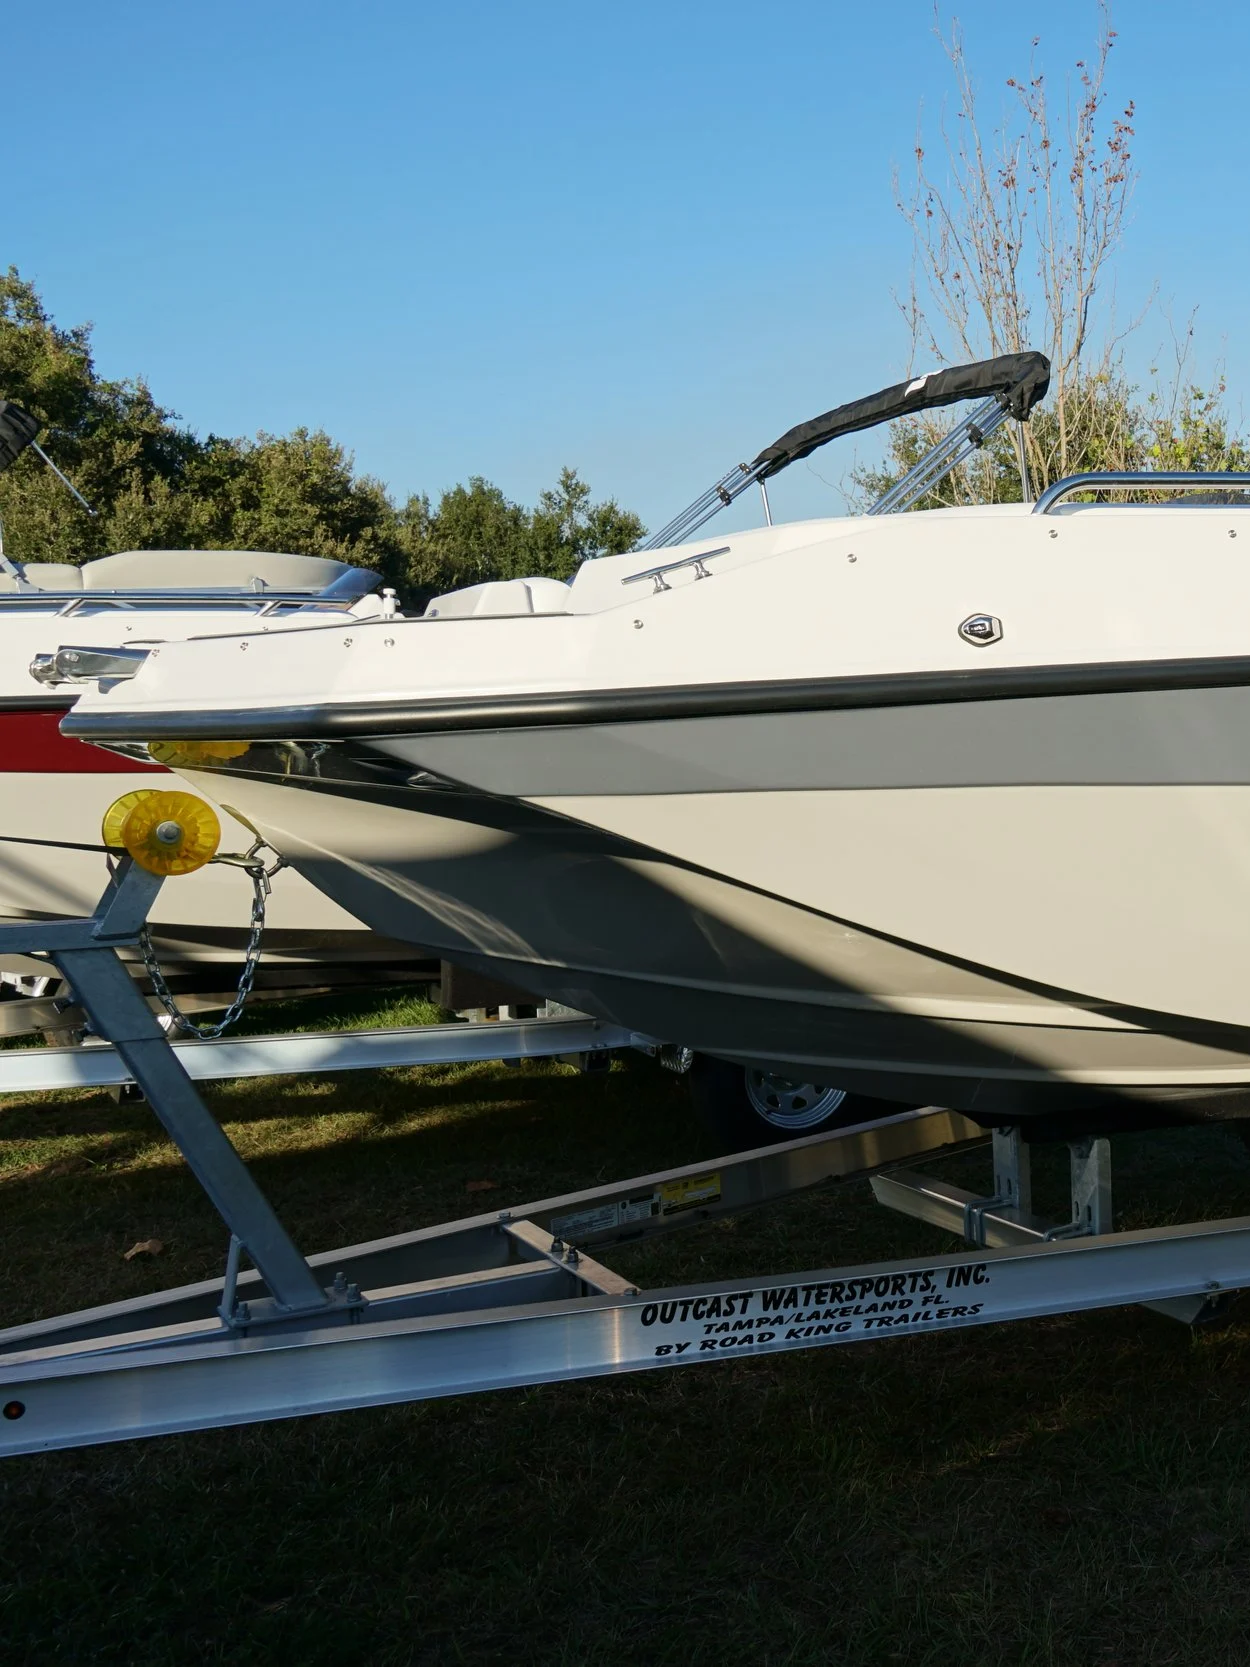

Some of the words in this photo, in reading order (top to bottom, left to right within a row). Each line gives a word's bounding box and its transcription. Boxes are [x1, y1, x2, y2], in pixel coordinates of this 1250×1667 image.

[641, 1291, 754, 1326] OUTCAST
[762, 1269, 937, 1312] WATERSPORTS,
[946, 1263, 990, 1288] INC.
[703, 1298, 913, 1335] TAMPA/LAKELAND
[921, 1294, 950, 1307] FL.
[654, 1342, 691, 1356] BY
[699, 1331, 776, 1351] ROAD
[785, 1321, 852, 1340] KING
[862, 1303, 984, 1329] TRAILERS
